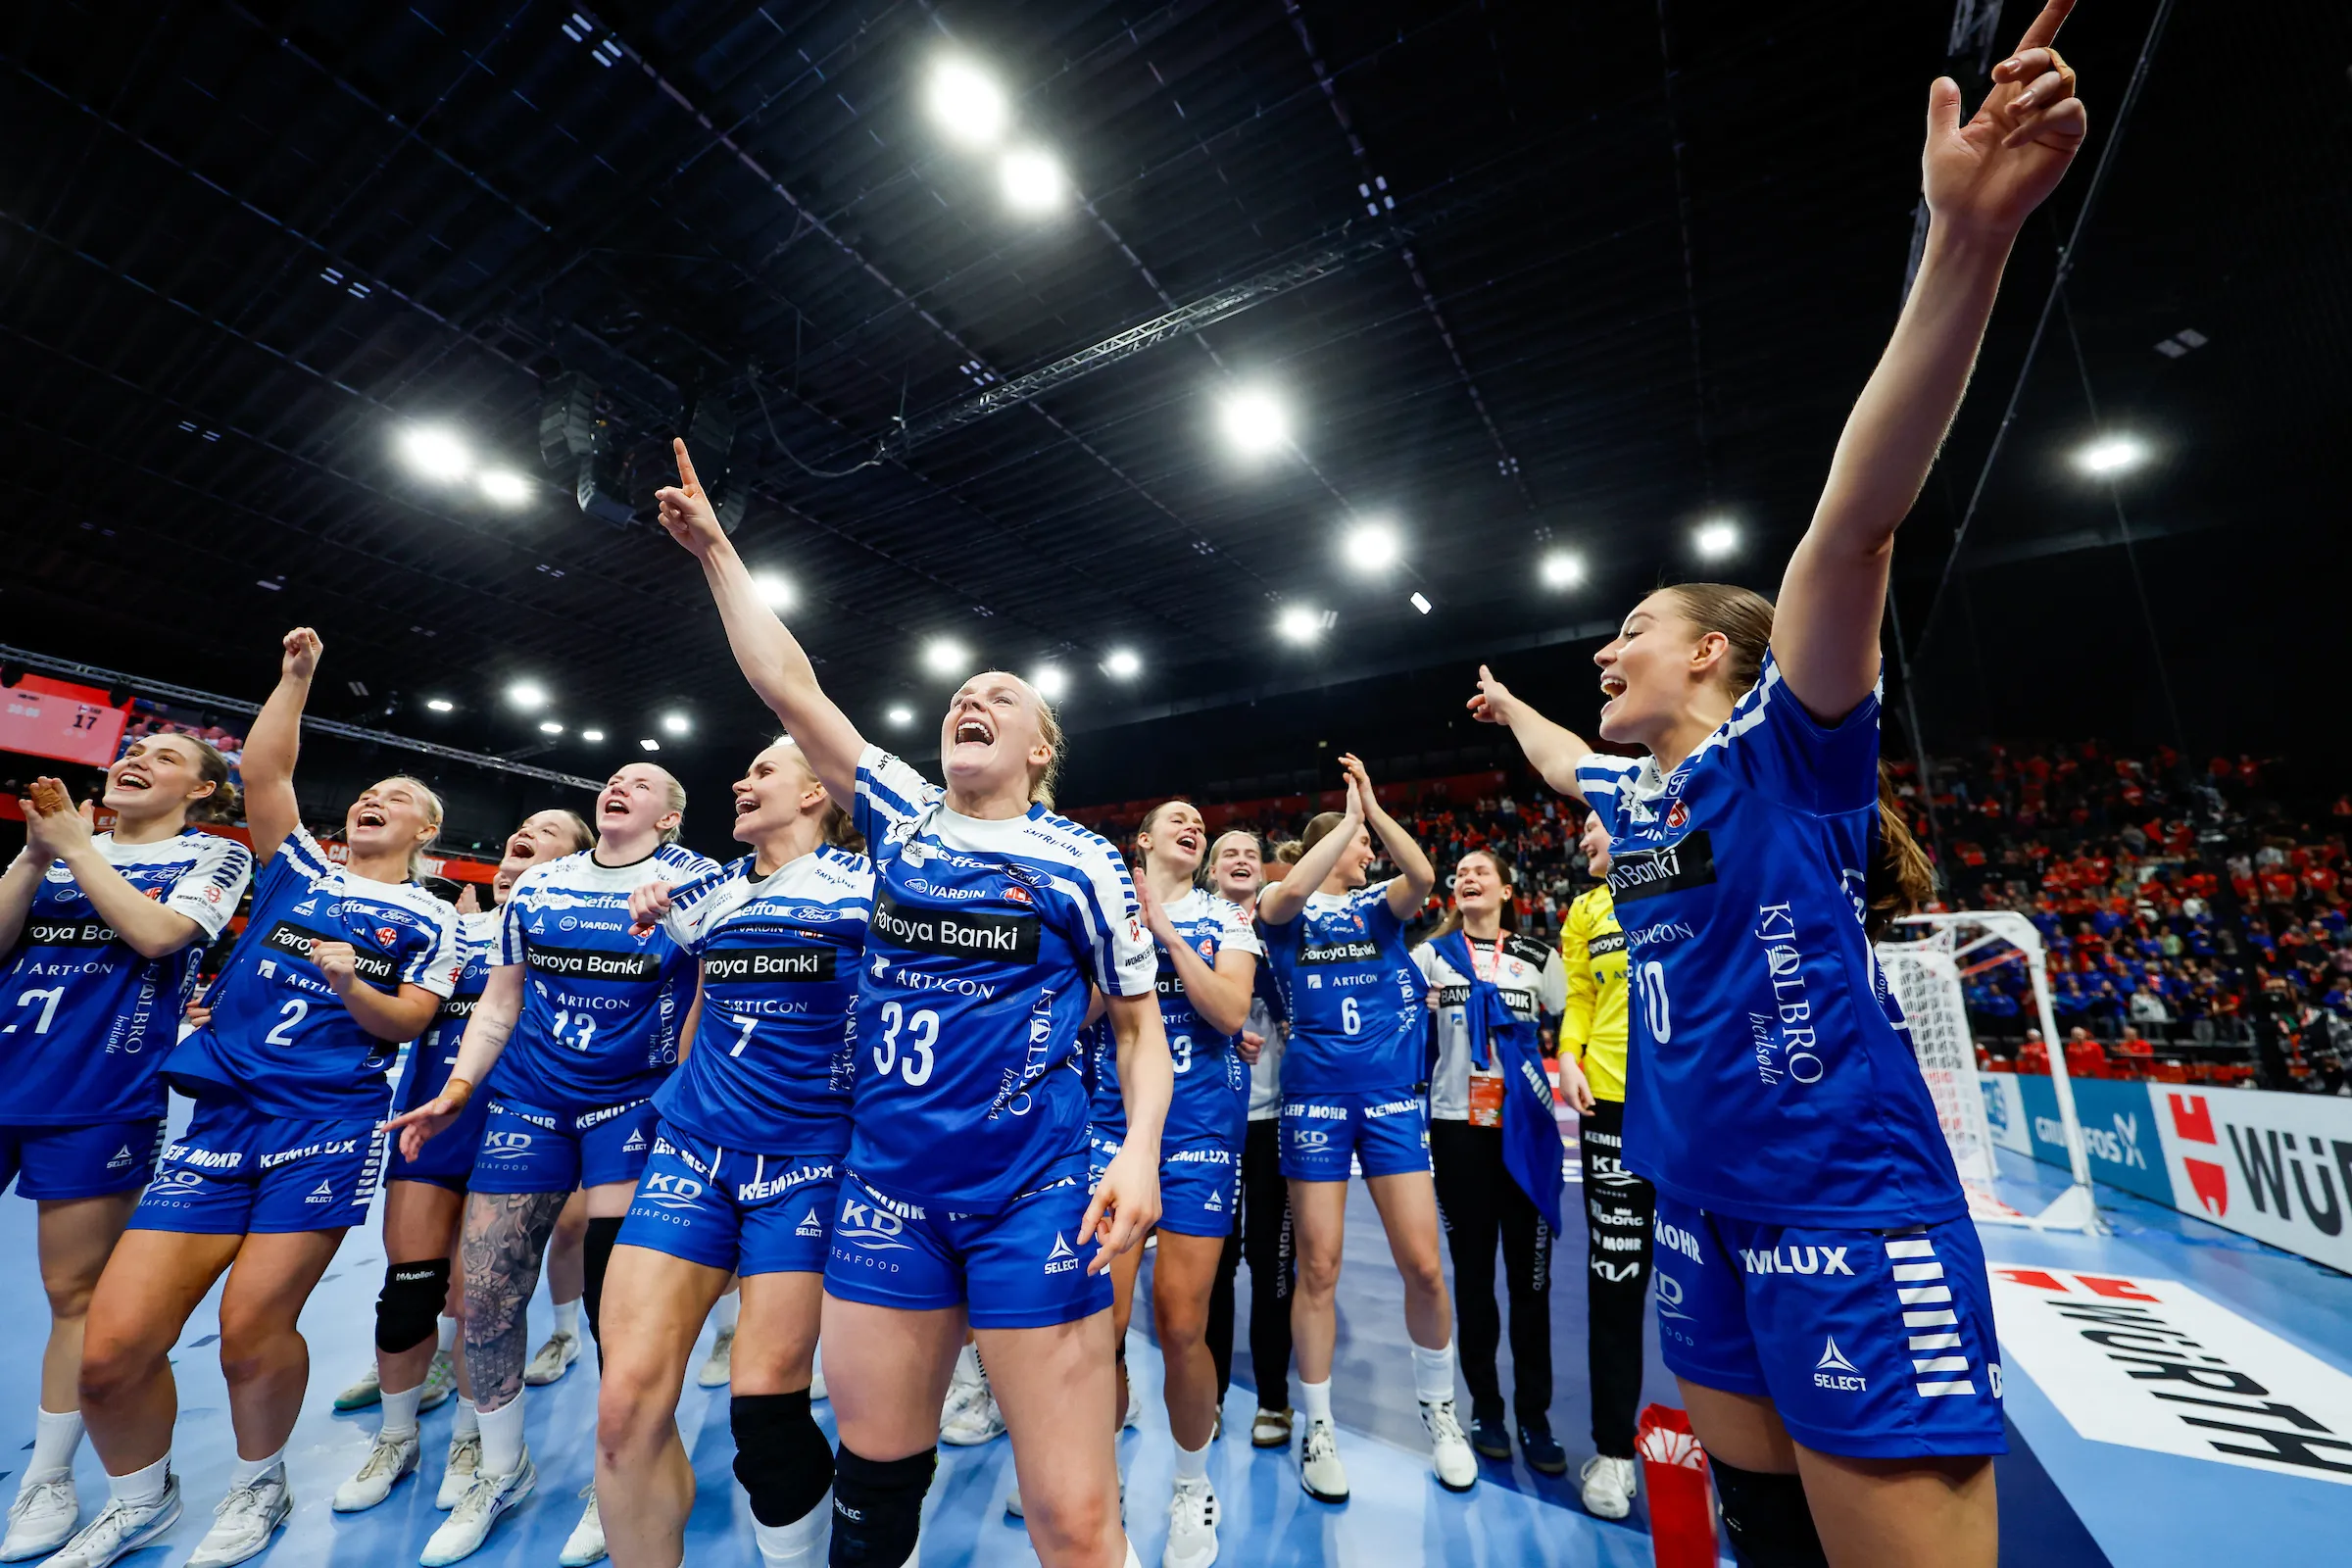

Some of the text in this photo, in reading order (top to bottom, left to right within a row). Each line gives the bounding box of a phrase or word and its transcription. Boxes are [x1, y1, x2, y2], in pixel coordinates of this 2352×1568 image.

[73, 714, 98, 730] 17
[1623, 849, 1681, 887] Banki
[342, 900, 366, 913] ffo
[586, 894, 622, 908] effo
[741, 901, 776, 916] effo
[381, 909, 413, 924] Ford
[798, 907, 832, 921] Ford
[30, 926, 76, 942] roya
[873, 903, 1018, 951] Føroya Banki
[272, 926, 392, 978] Føroy anki
[526, 948, 644, 975] Føroya Banki
[704, 954, 819, 978] øroya Banki
[284, 973, 338, 996] ARTIC
[557, 992, 631, 1010] ARTICON
[1636, 960, 1672, 1045] 10
[265, 998, 309, 1047] 2
[1341, 996, 1361, 1036] 6
[552, 1009, 597, 1053] 13
[729, 1014, 760, 1057] 7
[872, 1001, 940, 1087] 33
[1308, 1105, 1348, 1120] MOHR
[484, 1130, 532, 1149] KD
[622, 1143, 647, 1152] SELECT
[1294, 1130, 1329, 1145] KD
[107, 1157, 133, 1170] SELECT
[163, 1144, 243, 1168] EIF MOHR
[645, 1172, 703, 1200] KD
[305, 1194, 333, 1204] SELECT
[630, 1207, 691, 1227] SEAFOOD
[841, 1198, 904, 1237] KD
[795, 1226, 823, 1239] SELECT
[1602, 1236, 1642, 1251] MOHR
[1044, 1257, 1079, 1275] SELECT
[1813, 1373, 1867, 1393] SELECT
[2044, 1299, 2352, 1475] WÜRTH
[834, 1496, 861, 1521] SELEC
